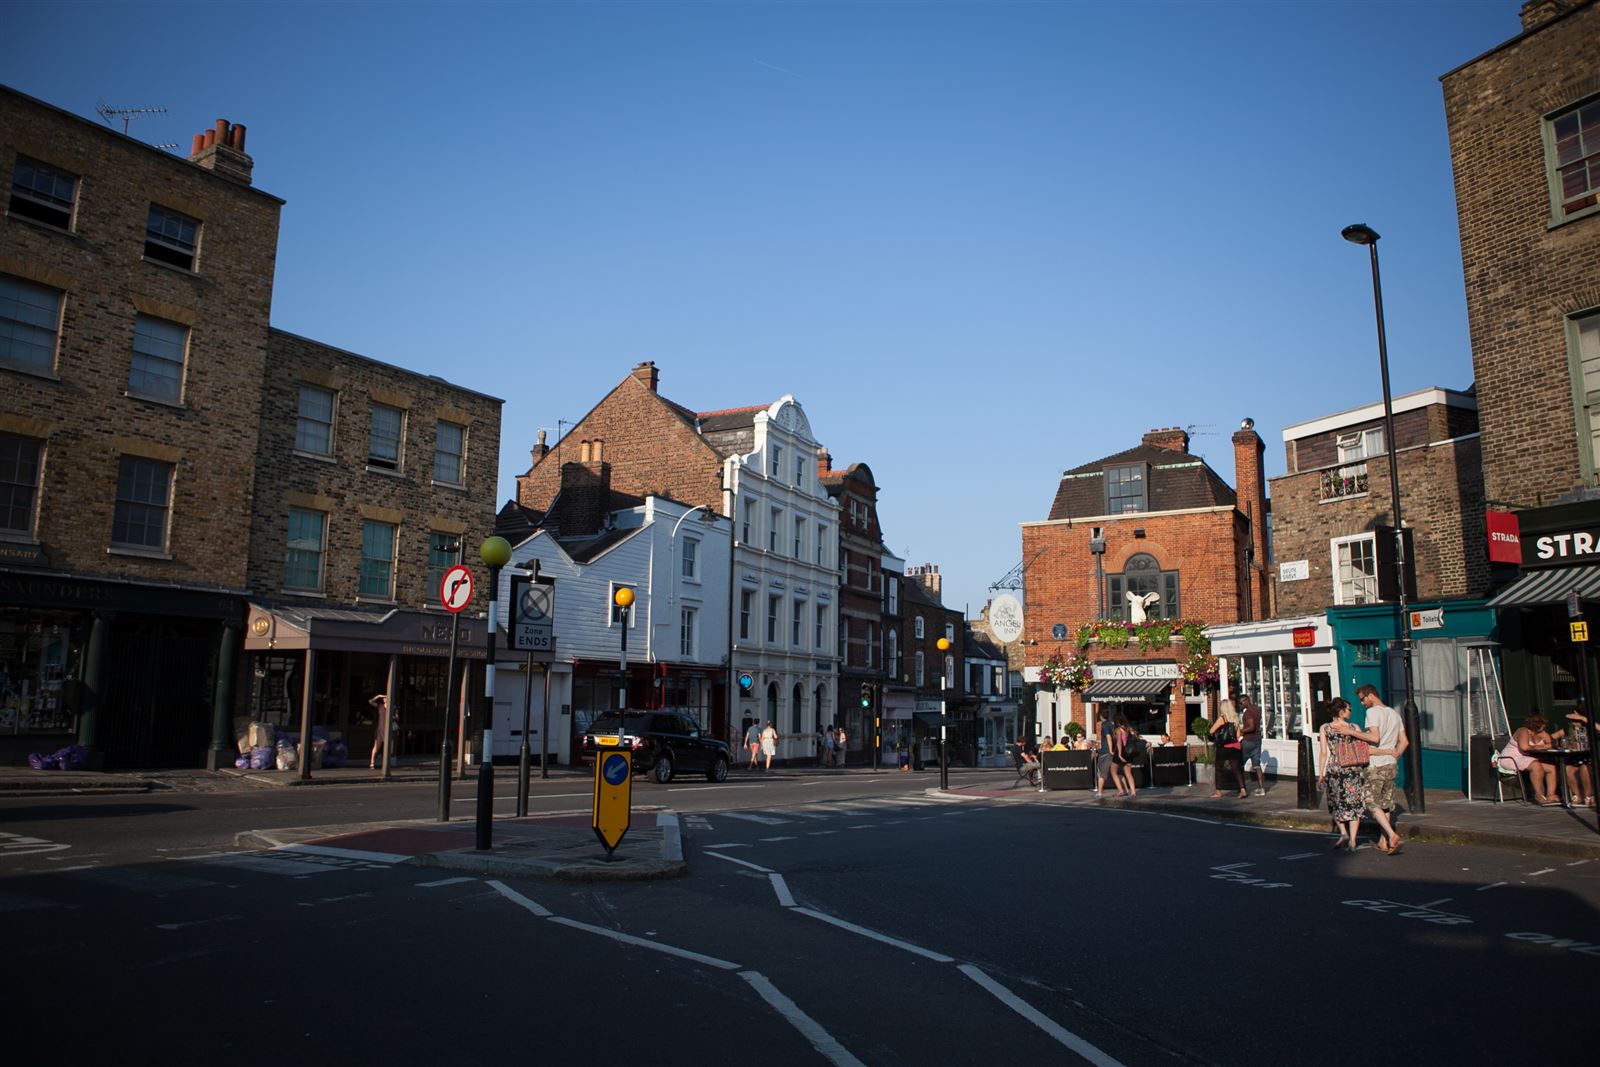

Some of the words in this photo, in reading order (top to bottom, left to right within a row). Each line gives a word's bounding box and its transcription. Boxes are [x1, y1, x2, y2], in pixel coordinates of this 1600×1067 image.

[1491, 532, 1519, 543] STRADA
[1, 580, 113, 600] SAUNDERS
[994, 620, 1021, 628] ANGEL
[524, 627, 543, 635] Zone
[1572, 624, 1586, 639] H
[519, 636, 548, 646] ENDS
[1114, 665, 1160, 677] ANGEL
[1161, 667, 1177, 675] INN
[1091, 695, 1145, 703] theangelhighgate.co.uk
[1209, 874, 1293, 888] CAR
[1340, 900, 1475, 925] CLUB
